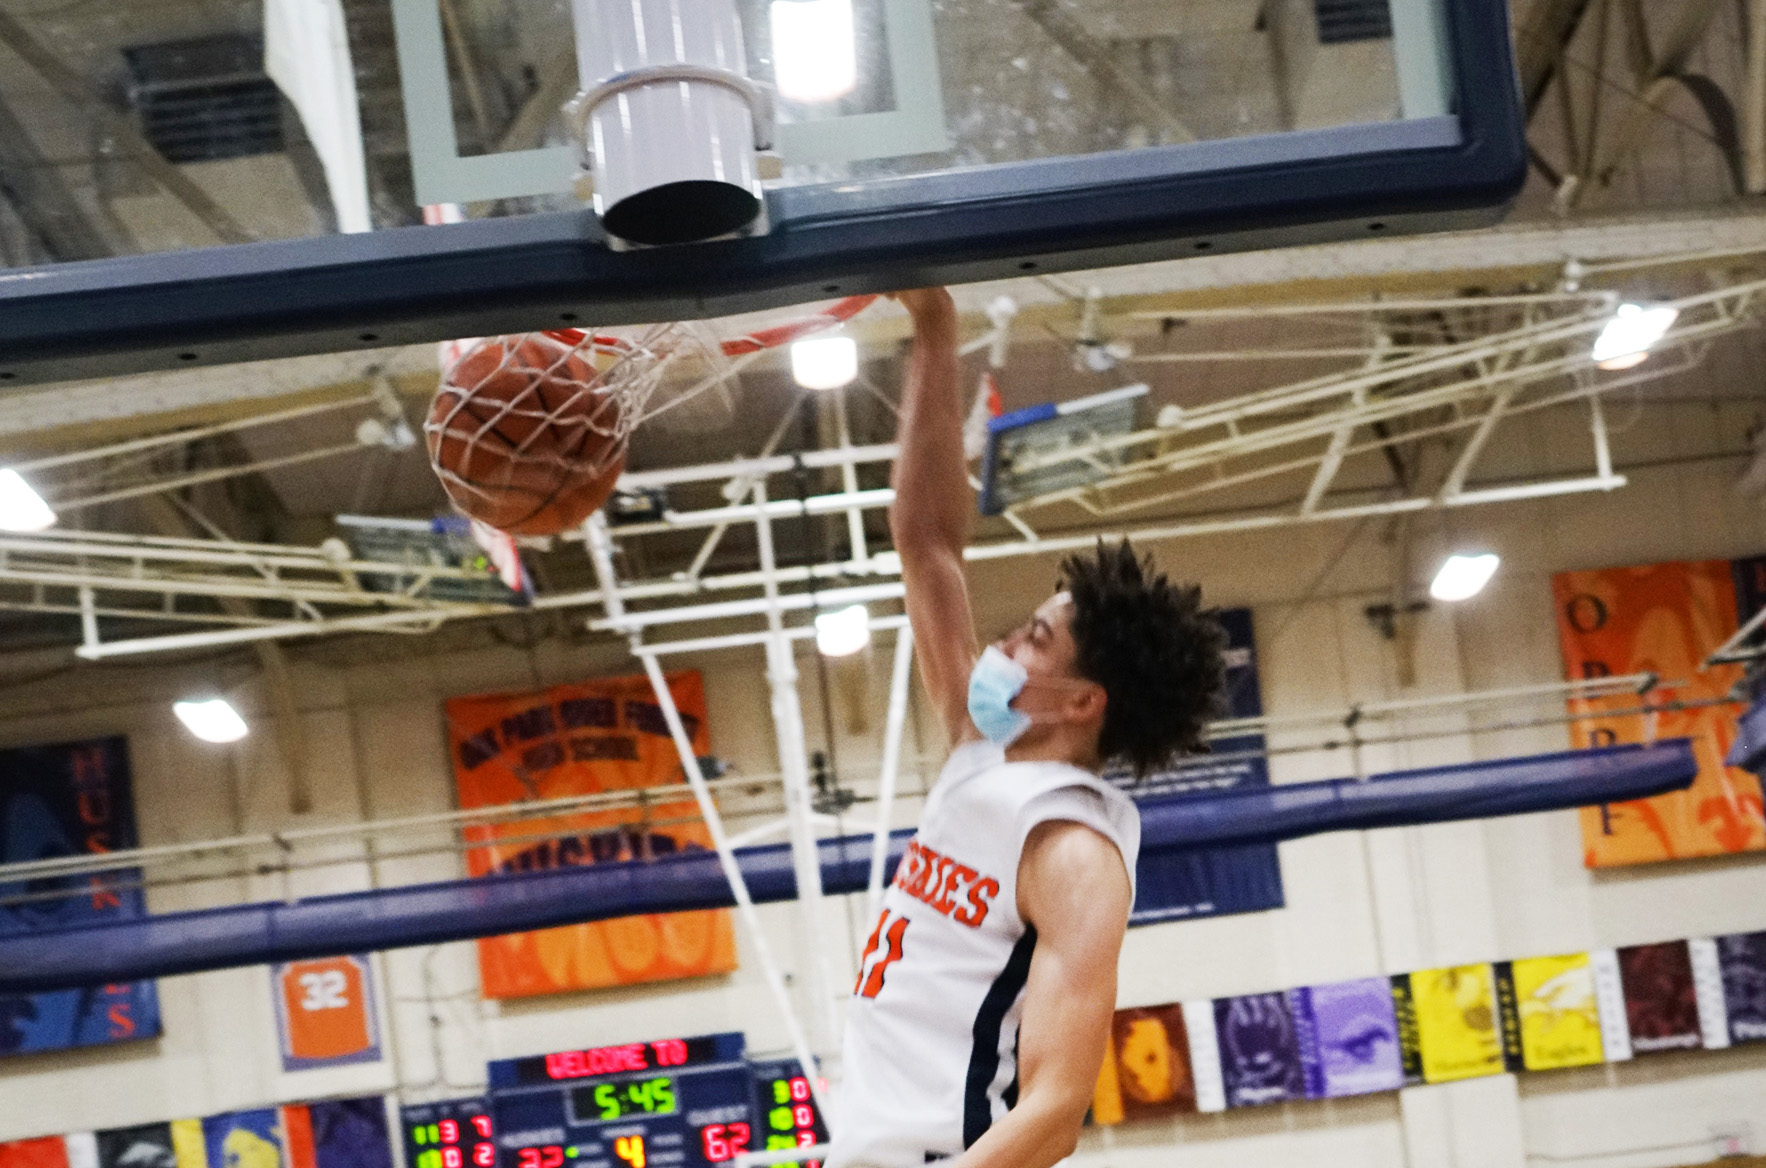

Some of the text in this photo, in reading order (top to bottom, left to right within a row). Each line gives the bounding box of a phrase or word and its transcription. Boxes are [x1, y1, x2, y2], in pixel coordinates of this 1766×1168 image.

[300, 970, 348, 1011] 32
[545, 1038, 688, 1079] WELCOME TO
[594, 1076, 676, 1120] 5:45
[788, 1076, 811, 1101] 0
[438, 1119, 460, 1144] 3
[470, 1115, 493, 1138] 7
[792, 1103, 814, 1129] 0
[472, 1142, 495, 1167] 2
[702, 1122, 750, 1162] 62
